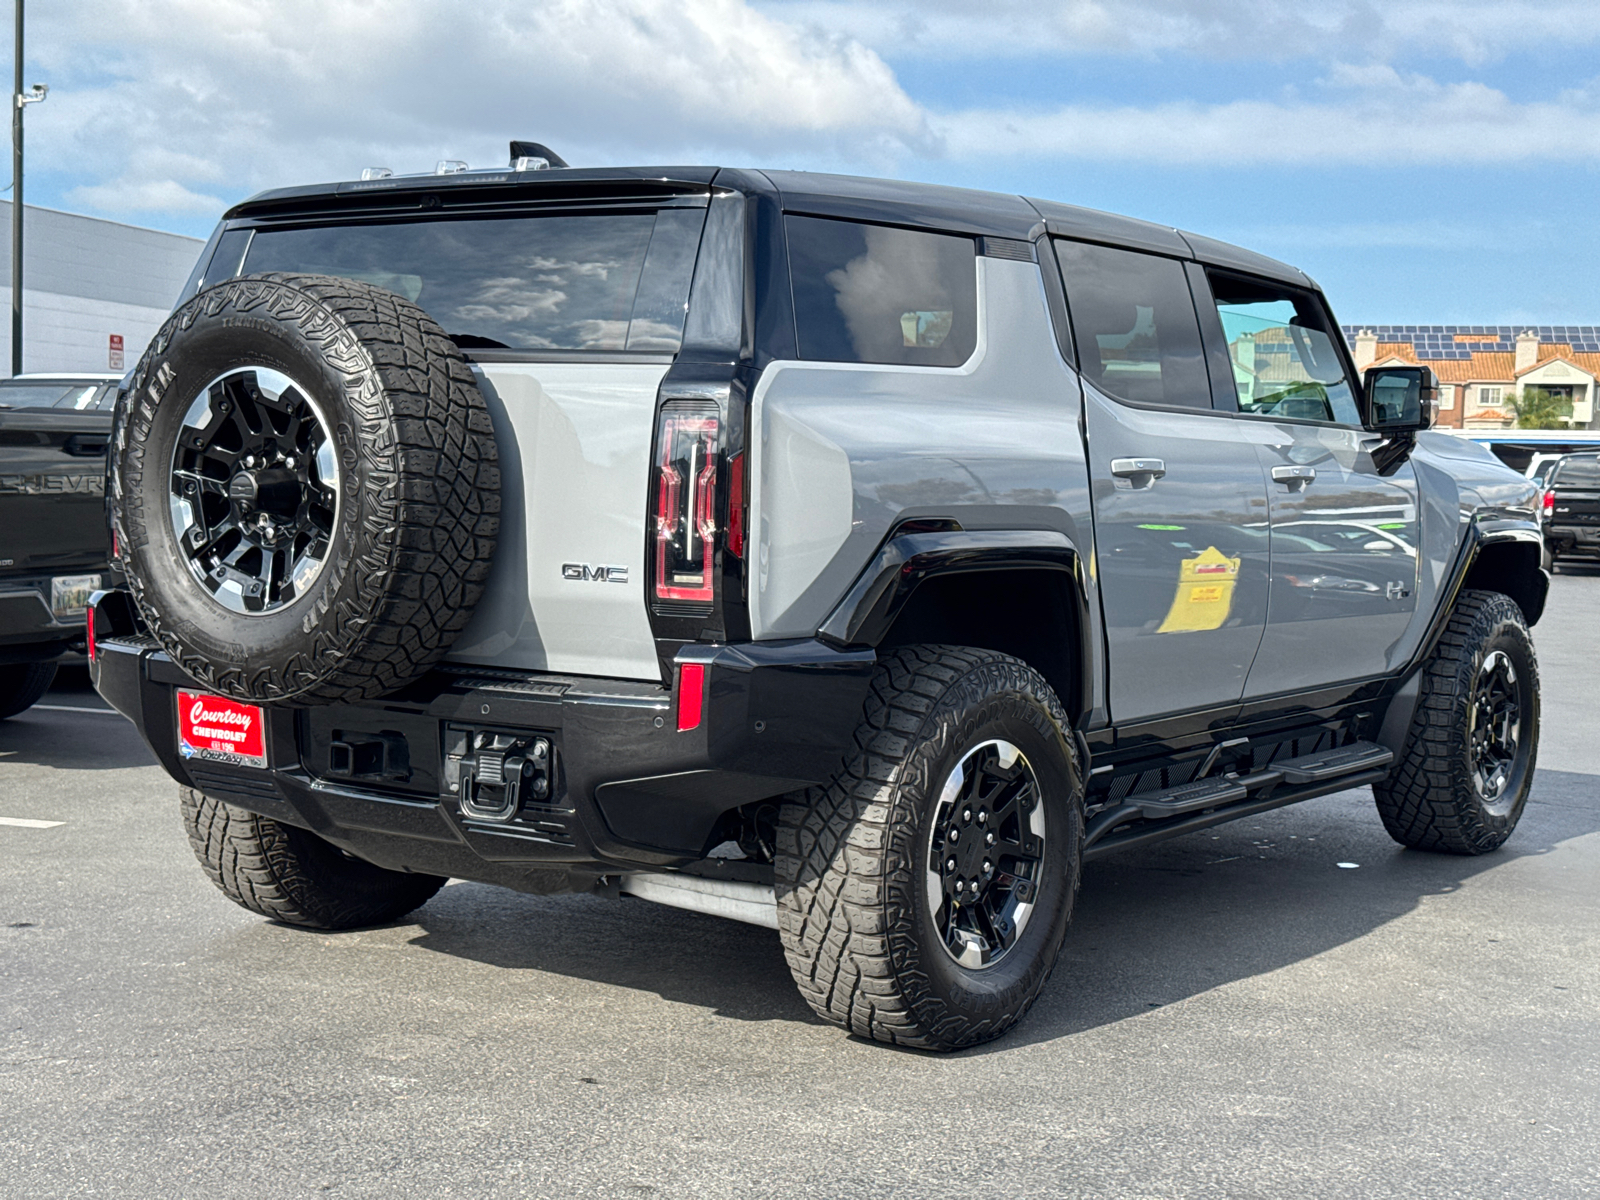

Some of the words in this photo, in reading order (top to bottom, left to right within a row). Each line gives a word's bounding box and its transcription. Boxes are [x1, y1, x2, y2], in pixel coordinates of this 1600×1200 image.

[126, 360, 177, 550] WRANGLER
[561, 562, 628, 583] GMC
[190, 701, 252, 731] Courtesy
[192, 726, 247, 742] CHEVROLET
